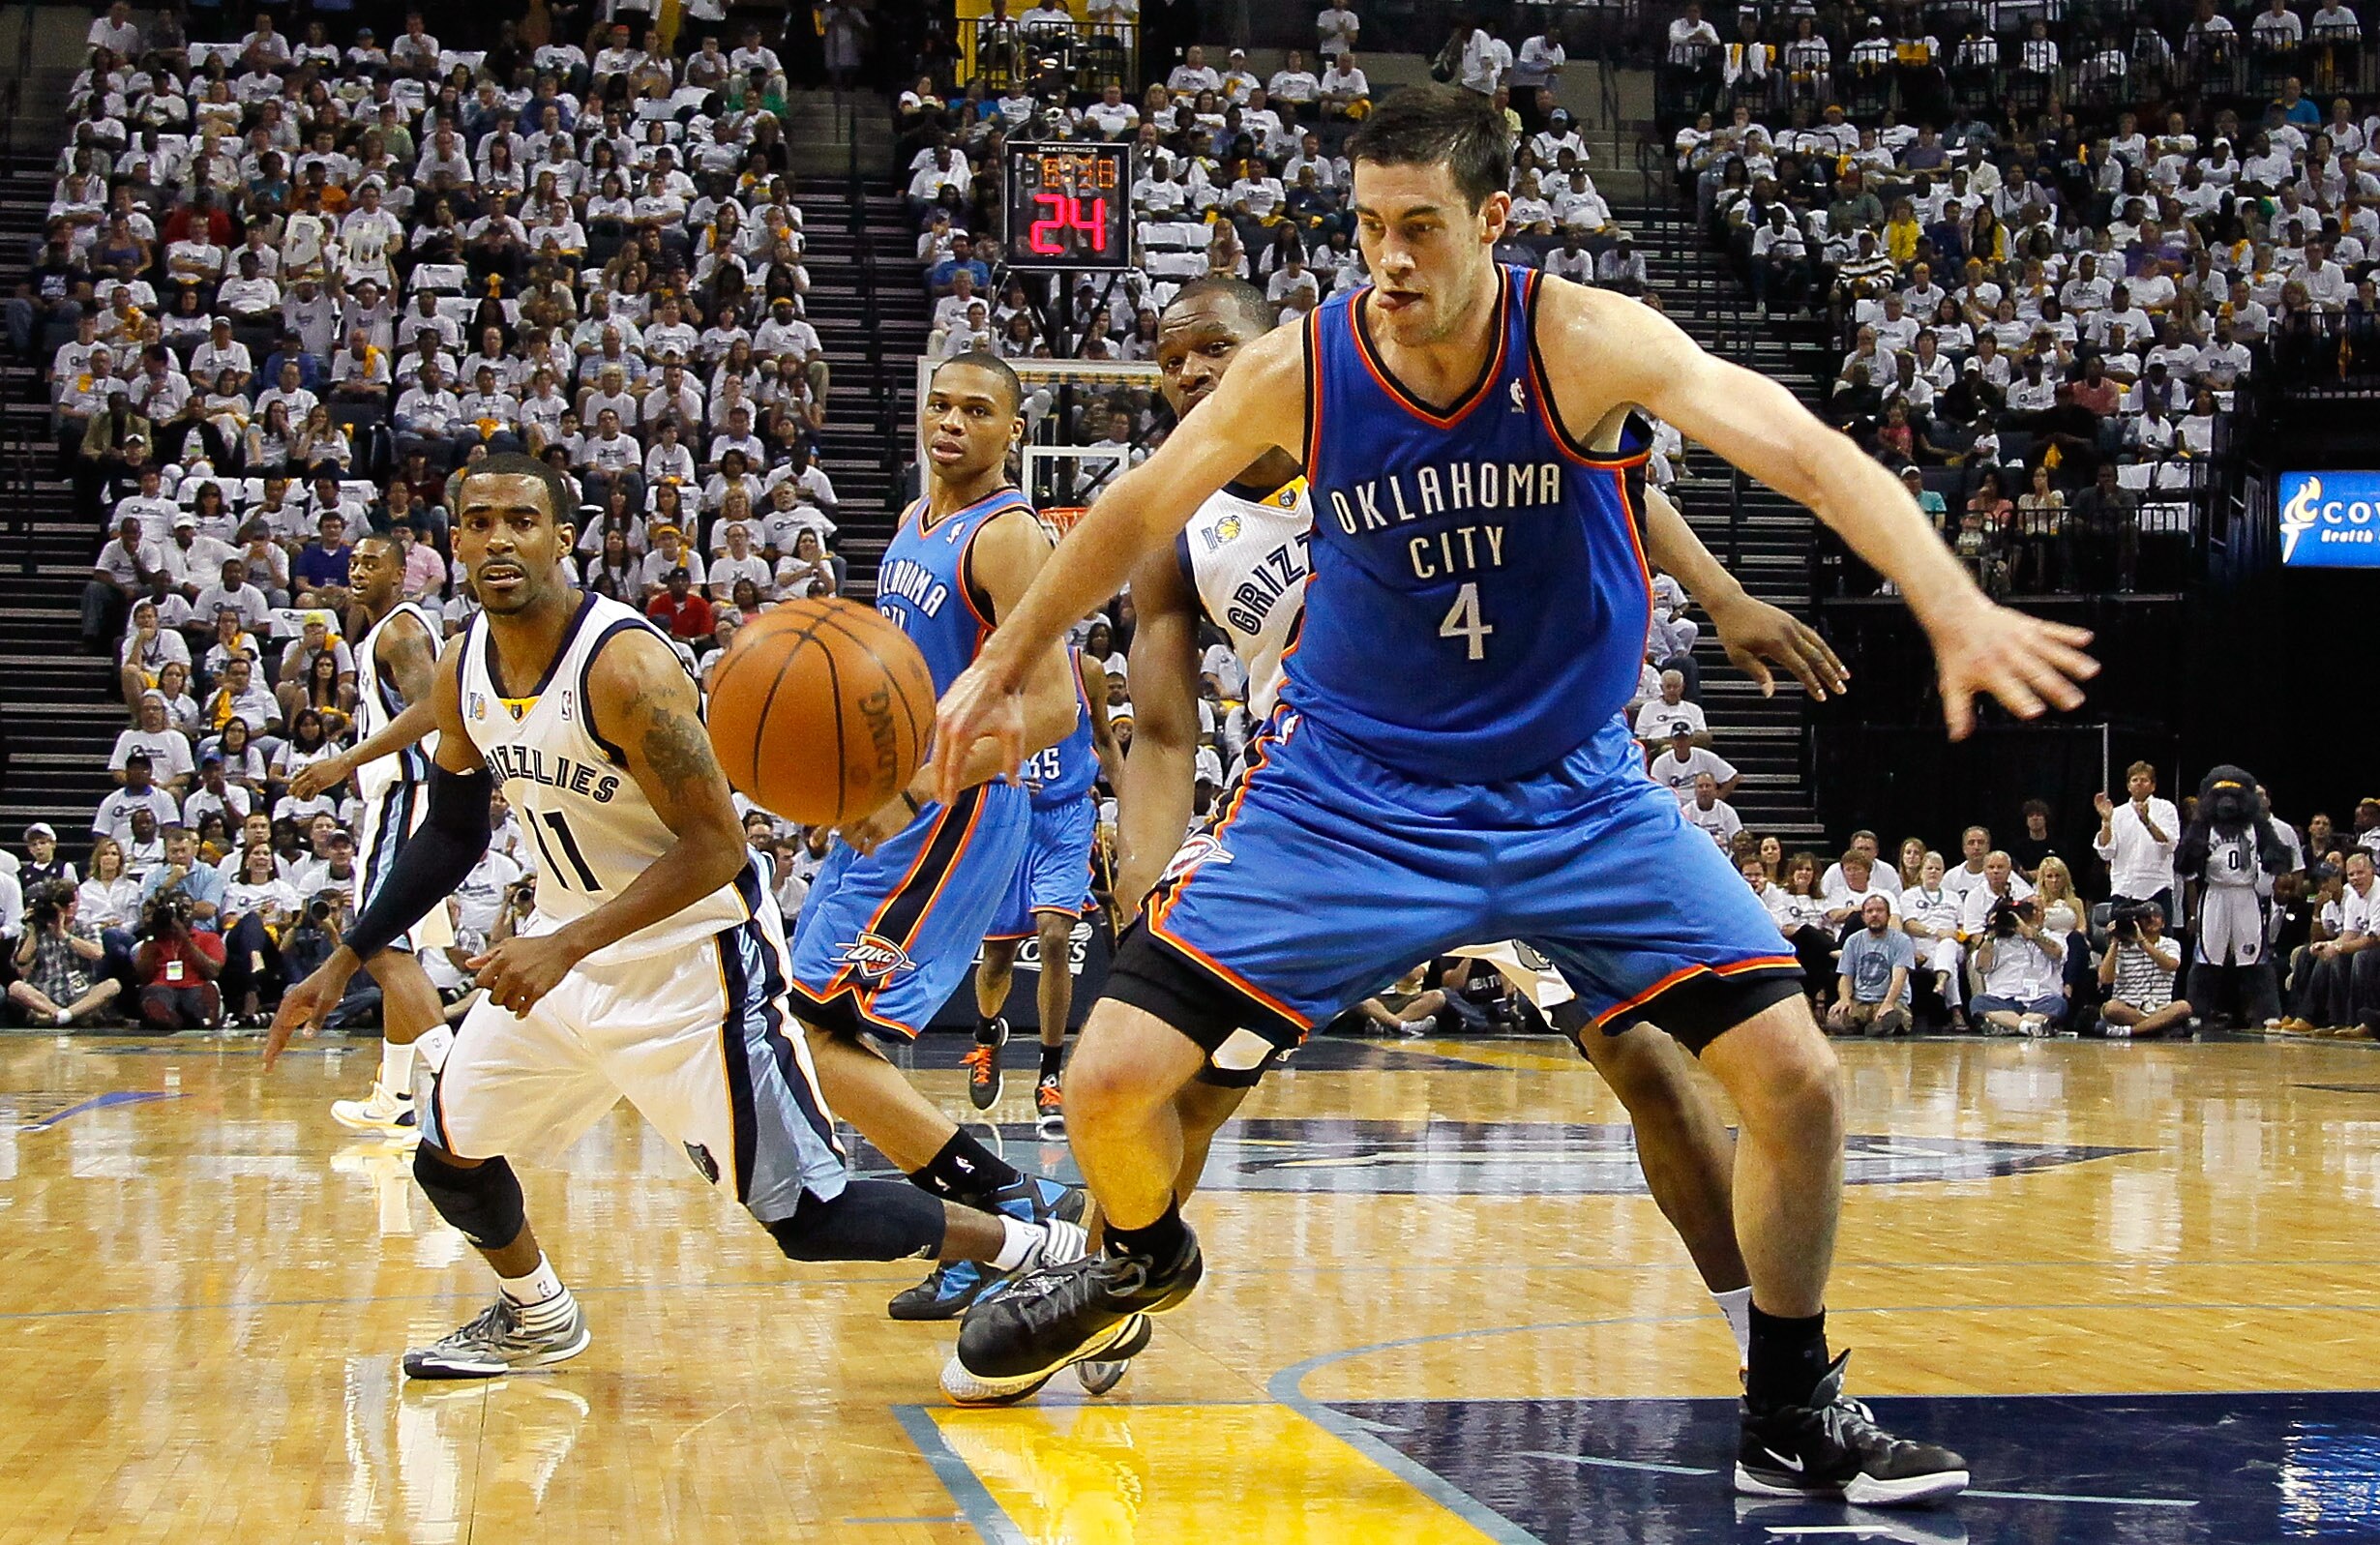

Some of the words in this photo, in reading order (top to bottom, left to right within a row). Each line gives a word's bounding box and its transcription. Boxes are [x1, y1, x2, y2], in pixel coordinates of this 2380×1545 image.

[1029, 193, 1106, 253] 24
[1330, 461, 1561, 535] OKLAHOMA
[1409, 525, 1503, 579] CITY
[1439, 581, 1493, 660] 4
[523, 806, 604, 893] 11
[847, 944, 897, 963] OKC
